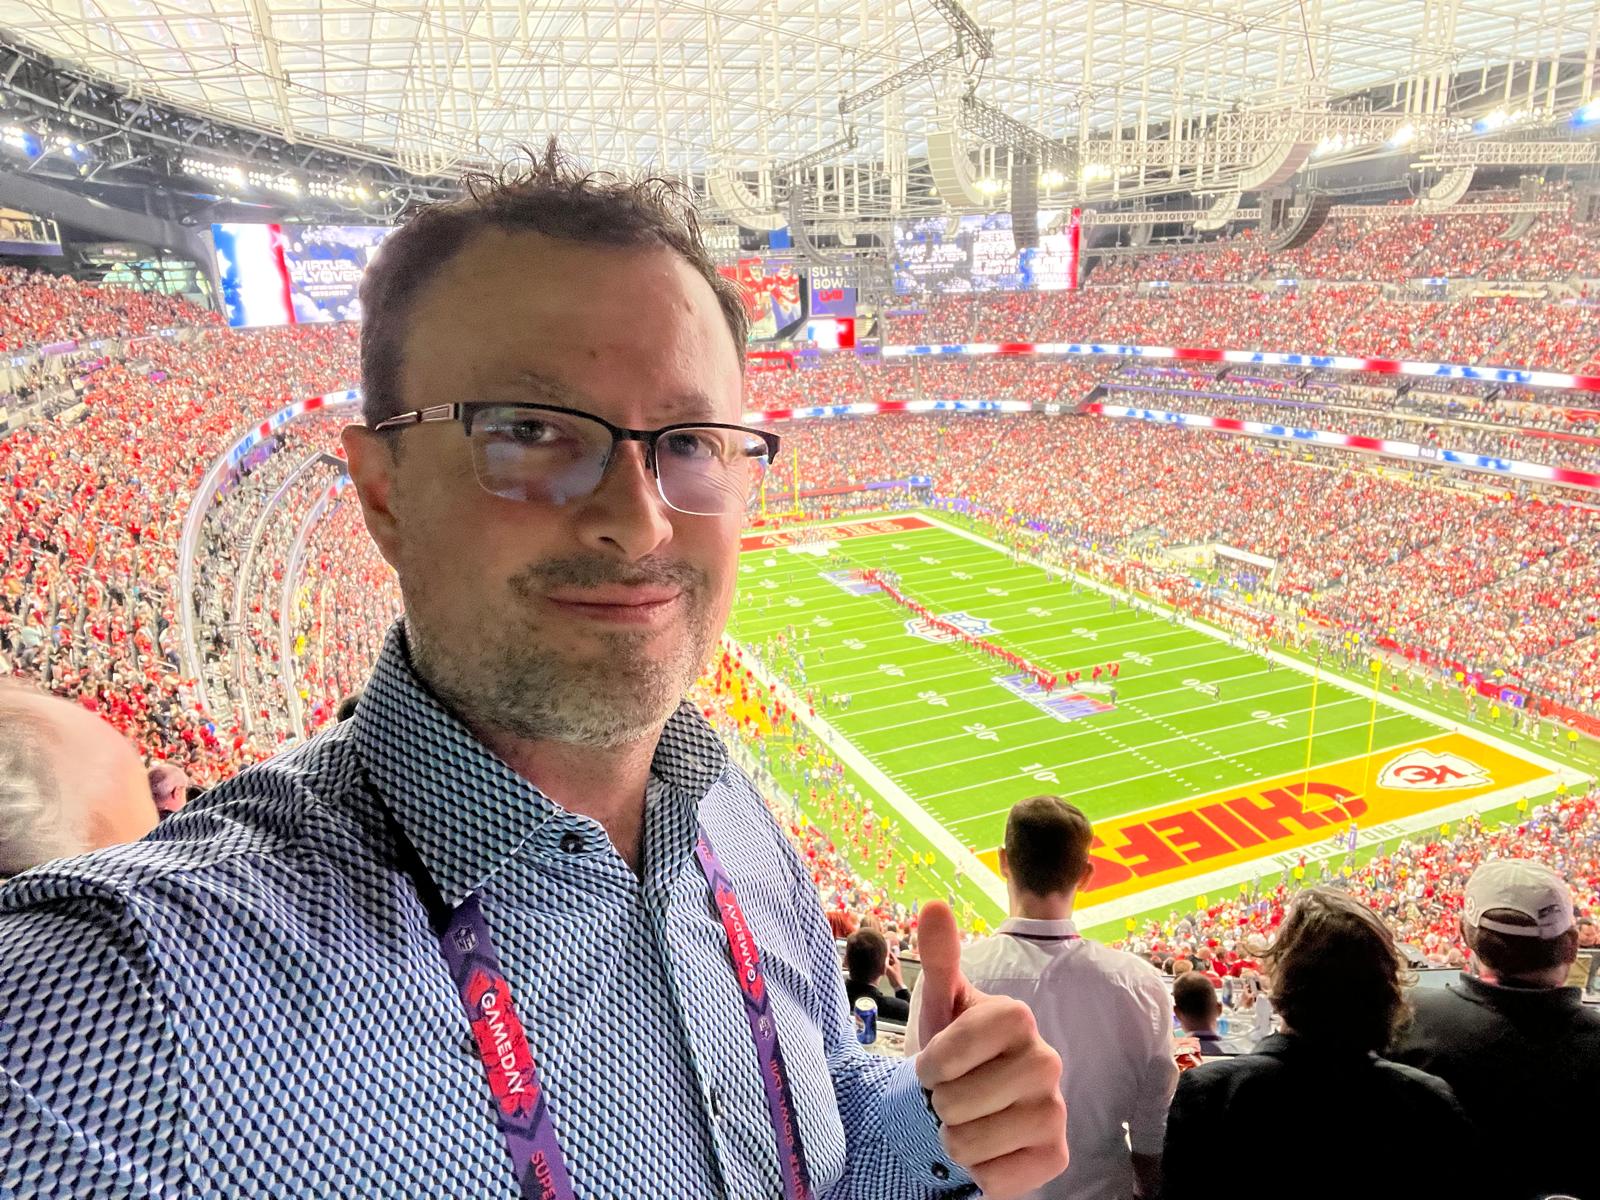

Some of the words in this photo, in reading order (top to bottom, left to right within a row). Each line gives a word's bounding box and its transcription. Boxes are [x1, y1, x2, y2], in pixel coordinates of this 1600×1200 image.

[918, 690, 945, 706] 30
[962, 722, 997, 740] 20
[1019, 762, 1057, 782] 10
[724, 903, 756, 982] GAMEDAY
[481, 992, 525, 1095] GAMEDAY
